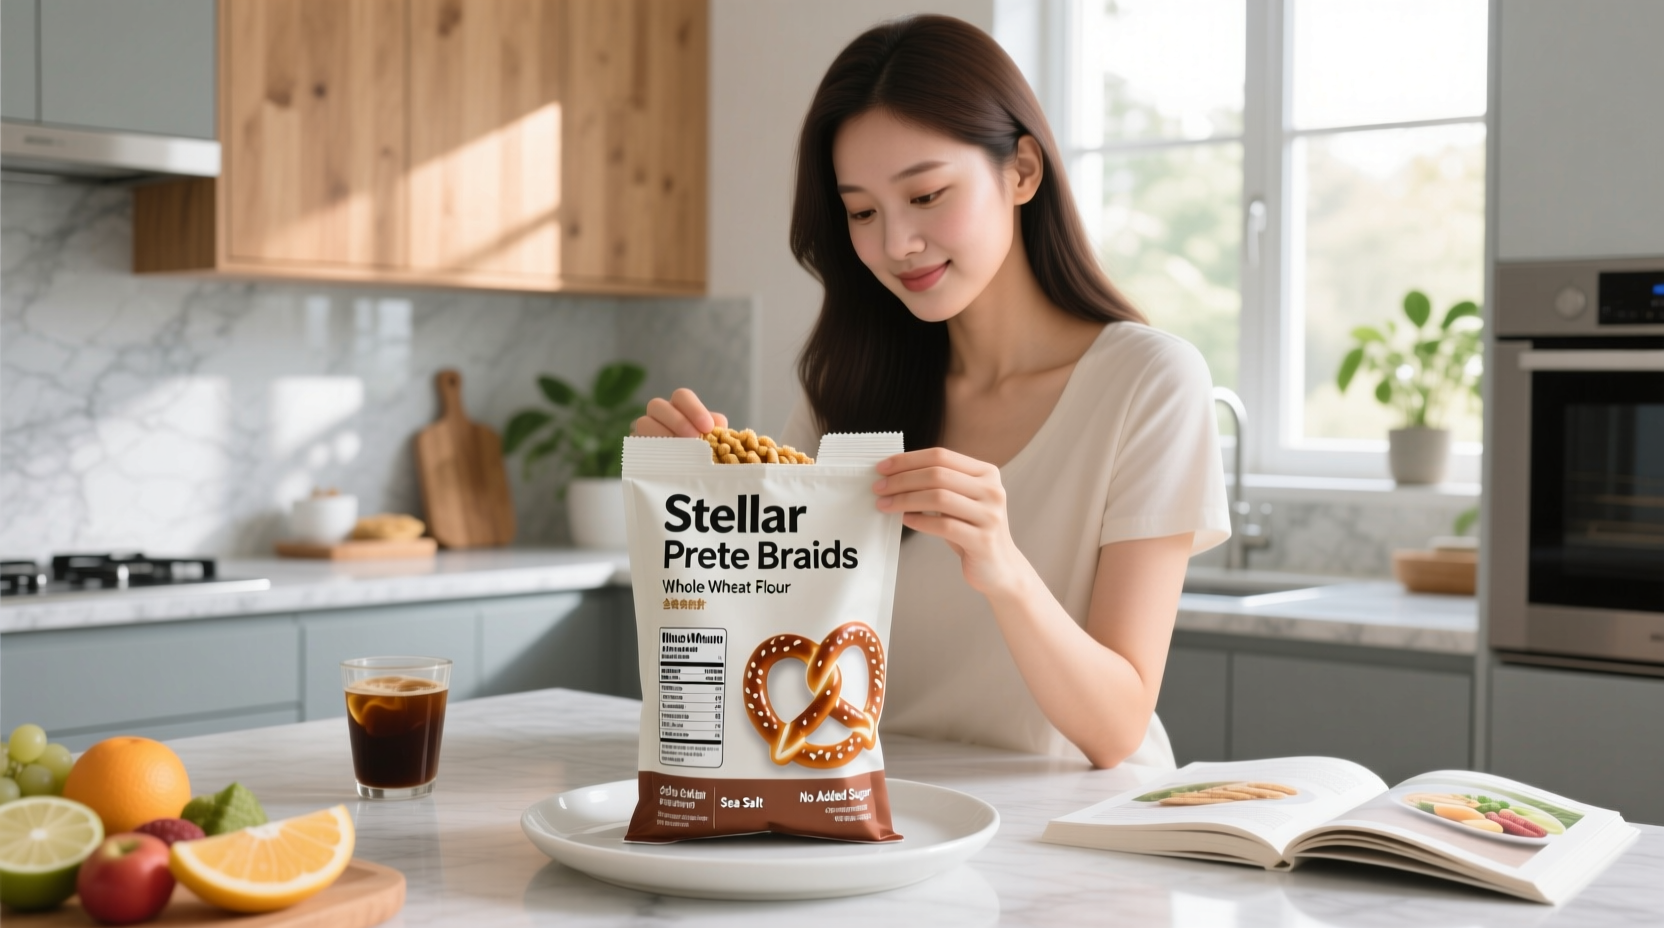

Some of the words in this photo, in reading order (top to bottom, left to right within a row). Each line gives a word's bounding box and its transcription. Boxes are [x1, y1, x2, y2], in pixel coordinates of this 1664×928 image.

[664, 493, 807, 533] Stellar
[663, 540, 750, 569] Prete
[758, 540, 858, 570] Braids
[662, 579, 705, 594] Whole
[708, 580, 751, 594] Wheat
[755, 580, 791, 594] Flour
[720, 796, 740, 808] Sea
[742, 796, 764, 809] Salt
[799, 790, 814, 803] No
